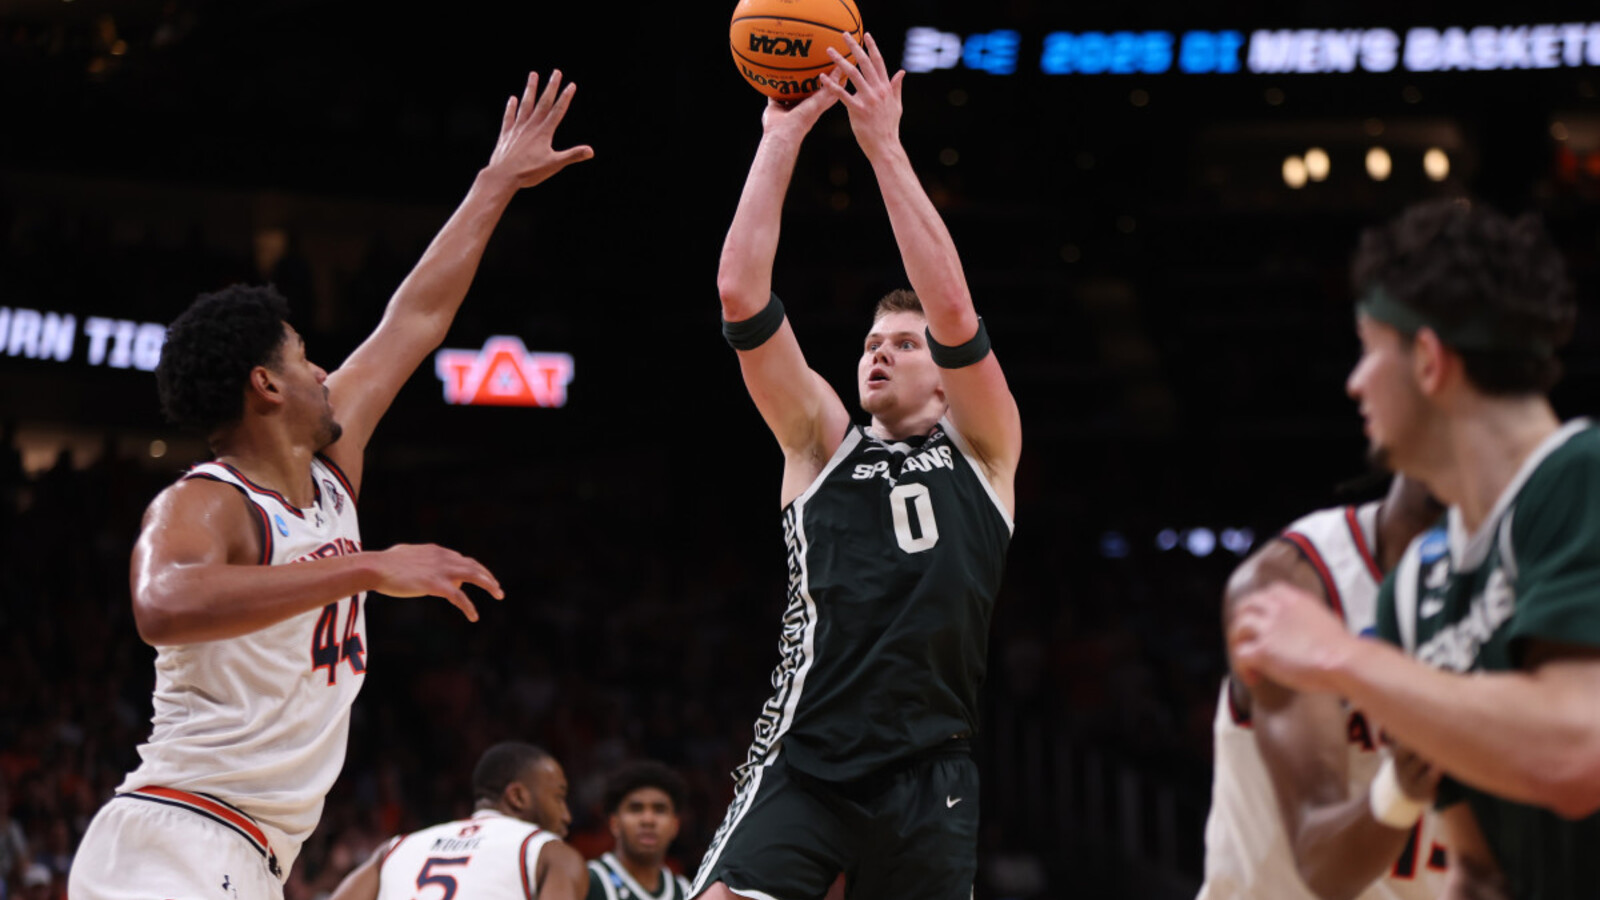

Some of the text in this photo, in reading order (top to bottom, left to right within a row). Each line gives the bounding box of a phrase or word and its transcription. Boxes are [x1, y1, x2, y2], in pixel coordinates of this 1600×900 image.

[749, 33, 812, 57] NCAA
[1040, 30, 1175, 75] 2025
[1248, 27, 1399, 74] MEN'S
[851, 445, 954, 488] SPANS
[889, 482, 940, 554] 0
[310, 593, 367, 687] 44
[416, 855, 471, 900] 5
